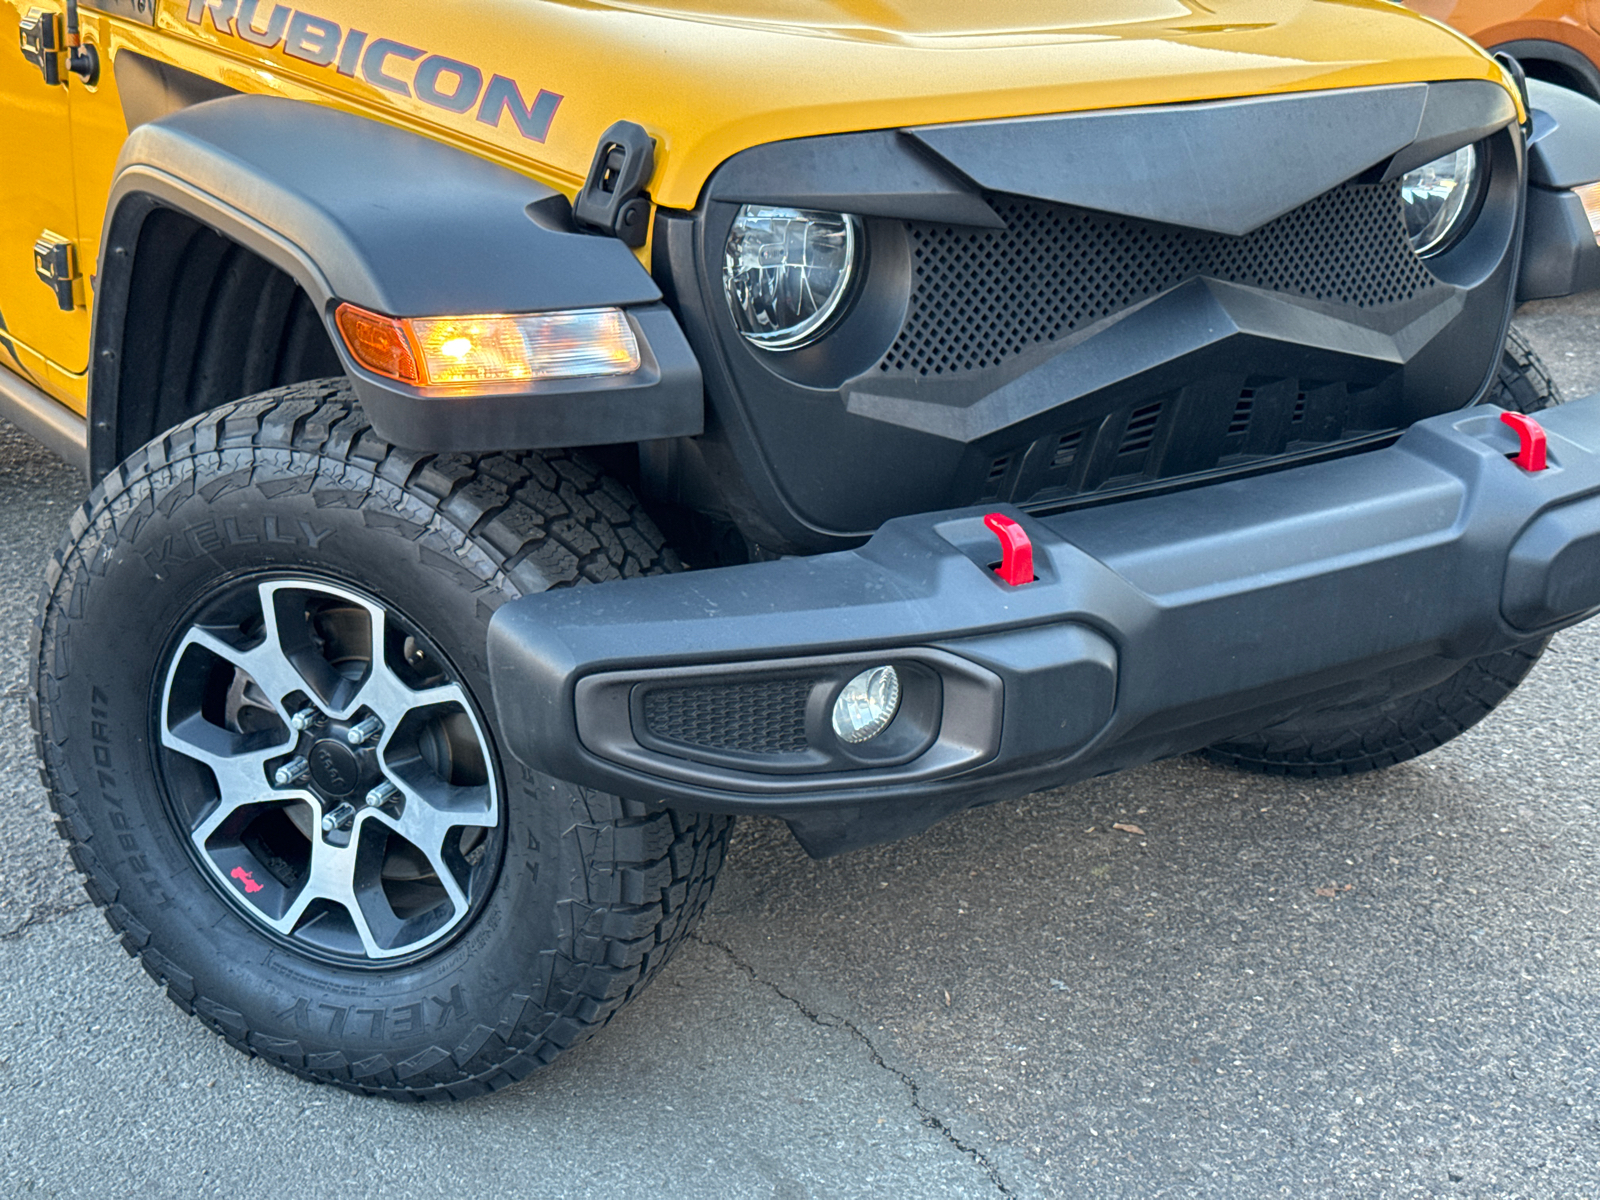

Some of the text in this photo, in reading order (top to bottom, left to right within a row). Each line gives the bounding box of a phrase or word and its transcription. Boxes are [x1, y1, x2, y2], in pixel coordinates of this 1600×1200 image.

[186, 0, 564, 144] RUBICON
[142, 514, 337, 579] KELLY
[276, 983, 469, 1041] KELLY
